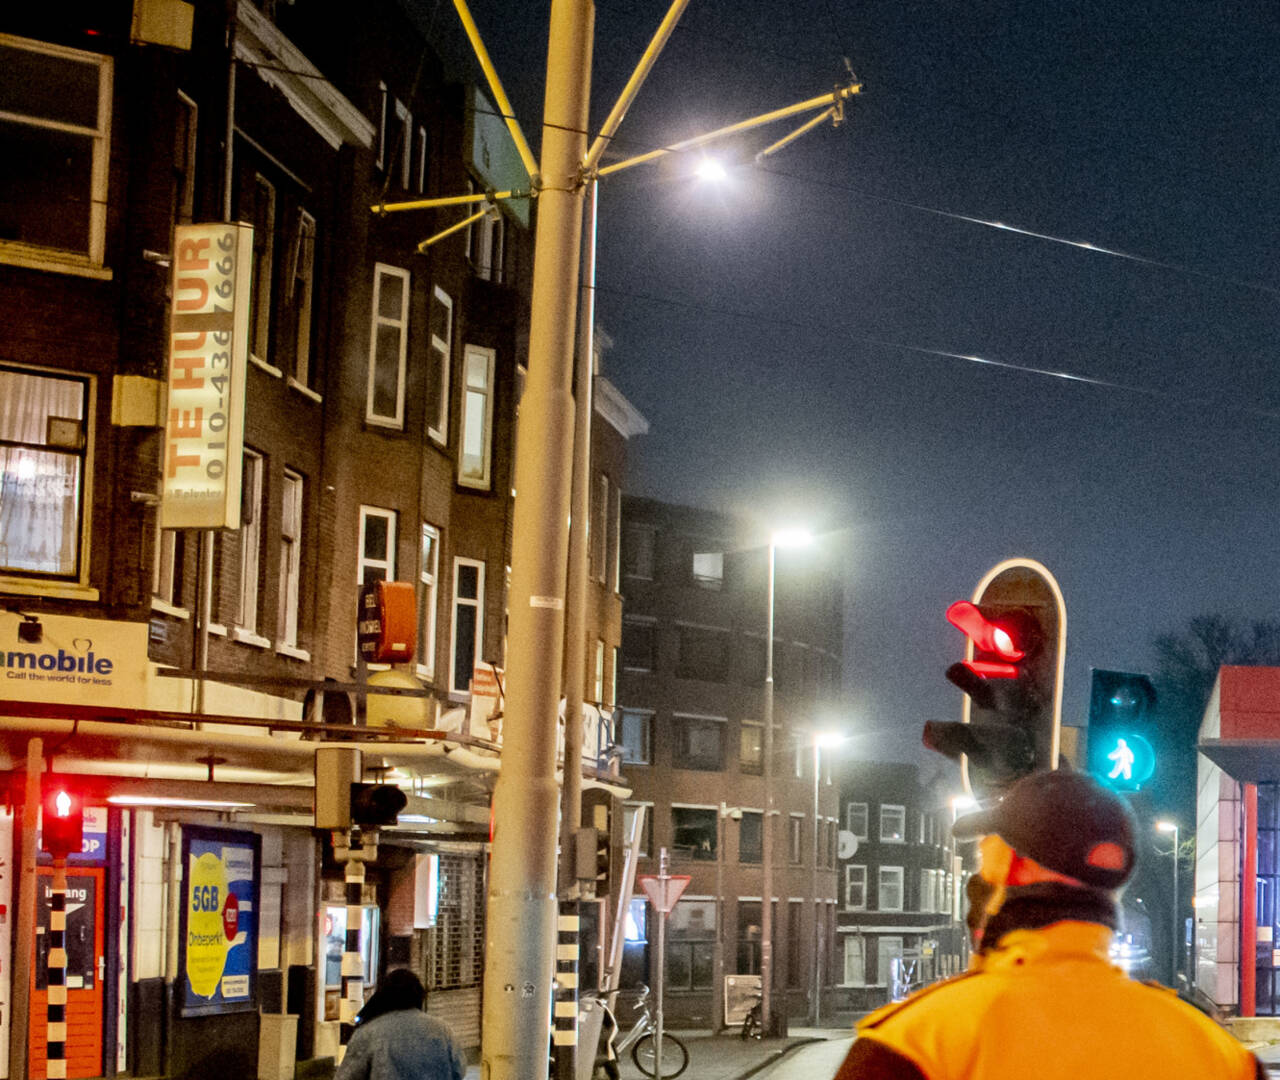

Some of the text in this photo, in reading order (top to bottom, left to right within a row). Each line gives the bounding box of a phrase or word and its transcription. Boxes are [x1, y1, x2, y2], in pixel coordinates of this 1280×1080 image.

[172, 238, 211, 390] HUUR
[167, 407, 203, 479] TE
[0, 648, 113, 675] mobile
[29, 672, 46, 681] the
[47, 674, 76, 684] world
[77, 676, 92, 684] for
[92, 678, 112, 686] less
[45, 886, 87, 901] inang
[192, 884, 219, 912] 5GB
